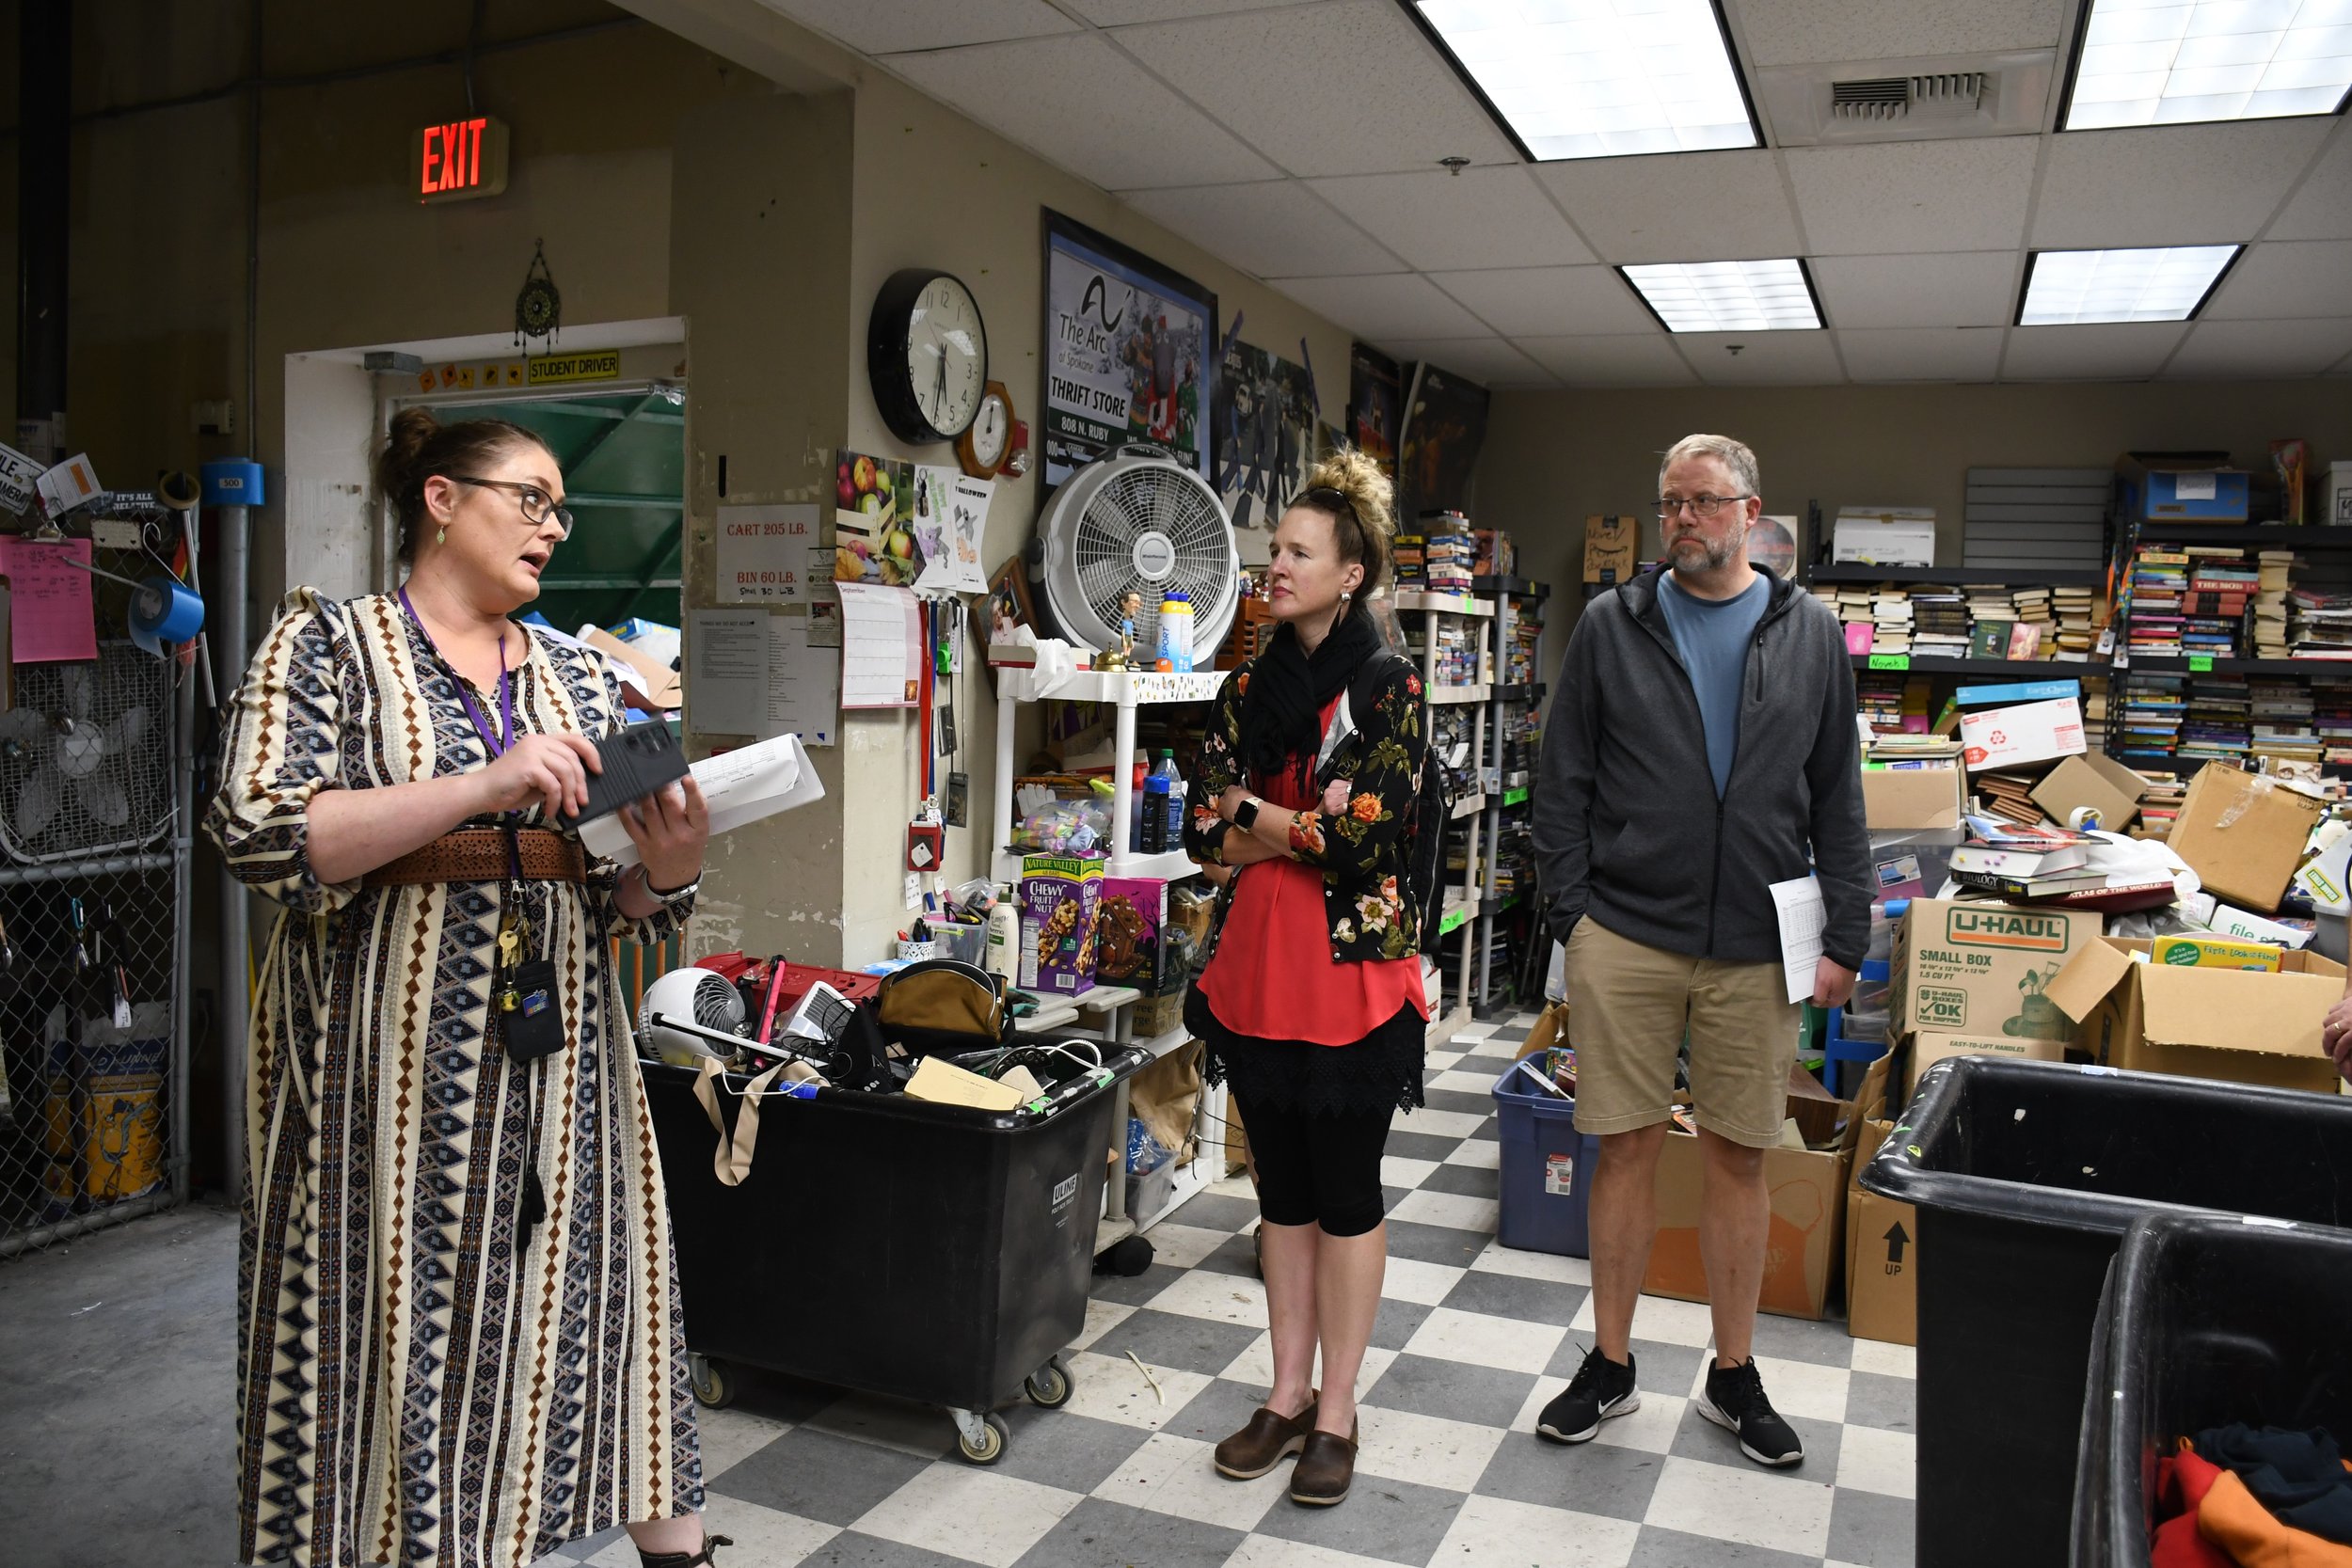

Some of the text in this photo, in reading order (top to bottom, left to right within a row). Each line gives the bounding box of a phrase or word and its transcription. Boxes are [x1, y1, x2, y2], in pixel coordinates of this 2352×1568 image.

[421, 119, 486, 194] EXIT
[941, 290, 950, 309] 12
[1060, 313, 1106, 354] The Arc
[532, 356, 617, 376] STUDENT DRIVER
[1058, 351, 1094, 374] of Spokane
[961, 388, 967, 403] 4
[1052, 376, 1125, 419] THRIFT STORE
[949, 405, 955, 421] 5
[1061, 417, 1076, 432] 808
[1078, 421, 1087, 436] N.
[1089, 425, 1108, 442] RUBY
[117, 493, 153, 501] IT'S ALL
[726, 522, 808, 536] CART 205 LB.
[737, 571, 758, 584] BIN
[760, 571, 776, 583] 60
[778, 571, 797, 583] LB.
[2197, 581, 2243, 590] THE MOB
[779, 586, 795, 595] LB
[1025, 857, 1080, 874] NATURE VALLEY
[1963, 871, 1998, 887] BIOLOGY
[1029, 881, 1067, 896] CHEWY
[2069, 882, 2162, 898] ATLAS OF THE WORLD
[1029, 895, 1053, 904] FRUIT
[1035, 904, 1054, 913] NUT
[1955, 913, 2060, 938] U-HAUL
[2230, 923, 2255, 939] file
[1920, 949, 1992, 966] SMALL BOX
[2204, 944, 2227, 956] First
[2230, 947, 2248, 958] Look
[2258, 952, 2277, 961] Find
[1934, 1003, 1962, 1017] OK
[1949, 1040, 1994, 1050] EASY-TO-LIFT
[1055, 1178, 1075, 1200] ULINE
[1884, 1263, 1902, 1276] UP
